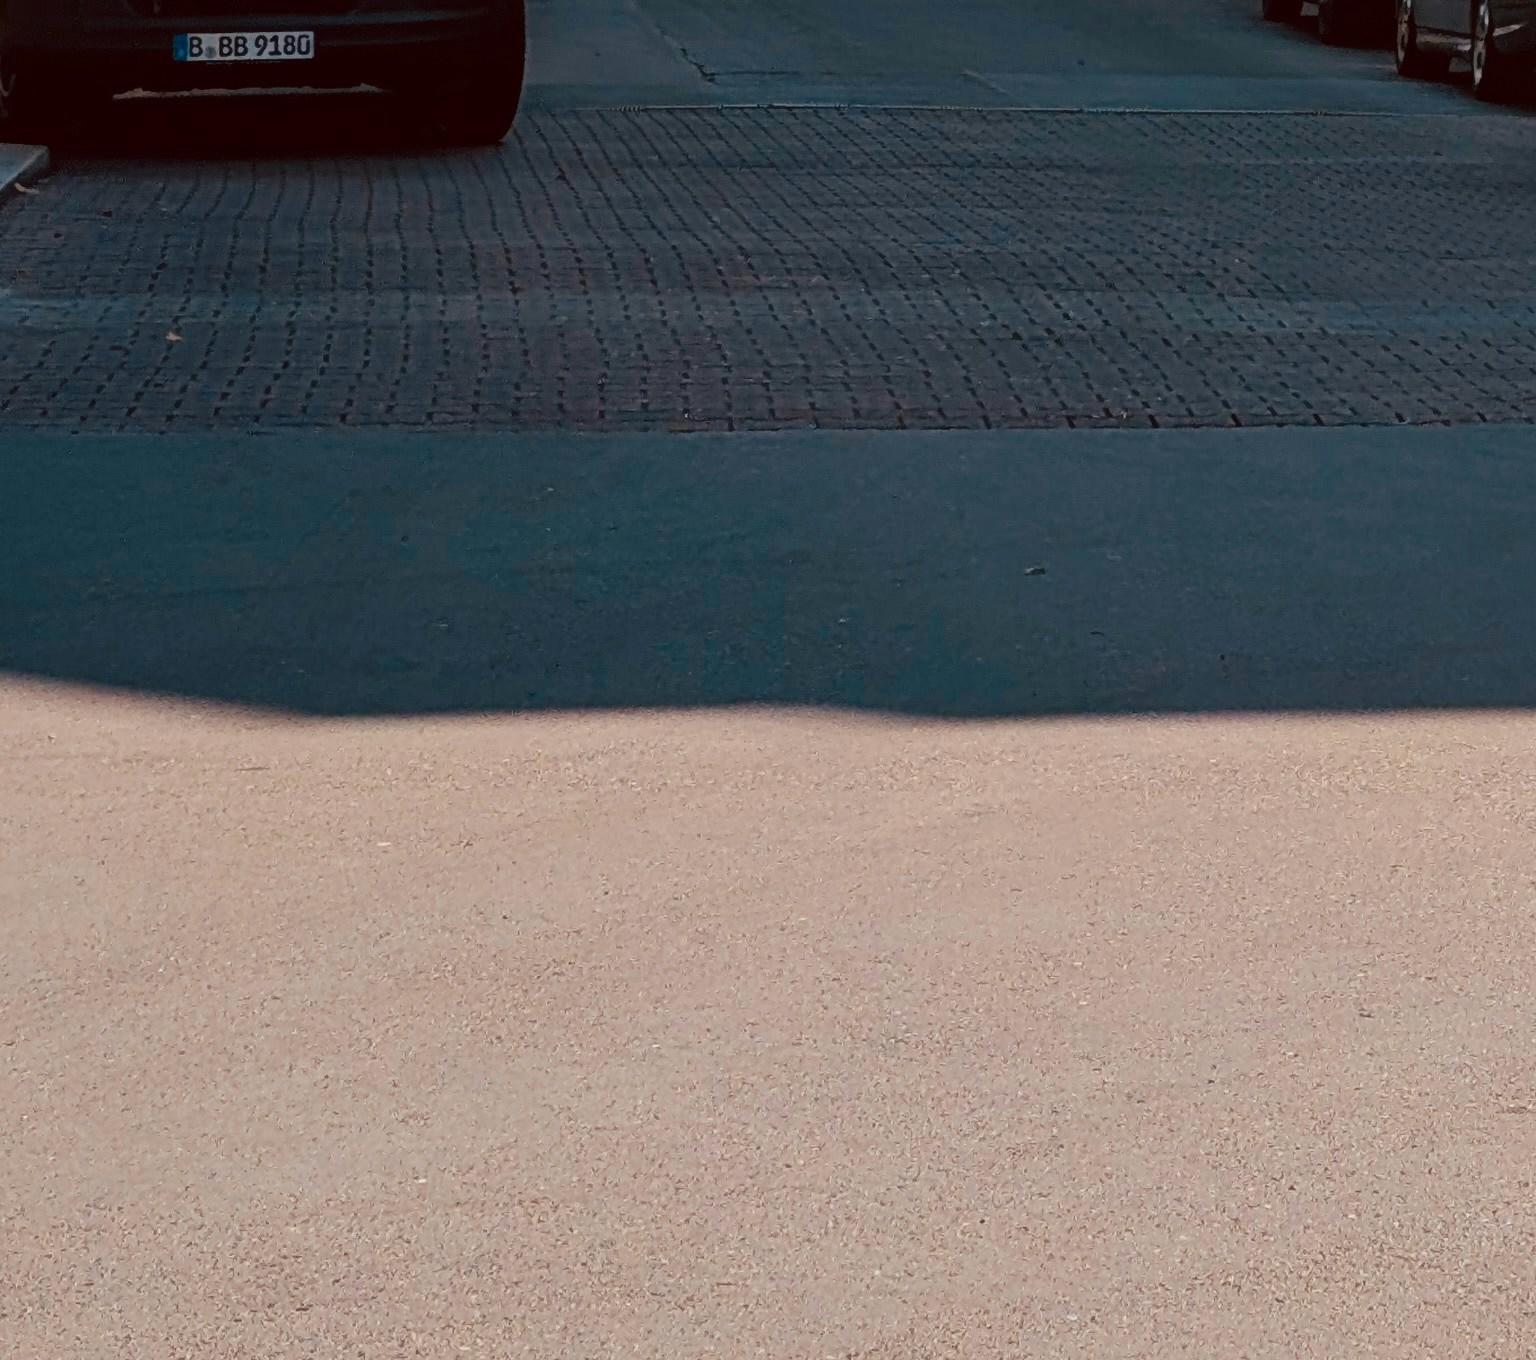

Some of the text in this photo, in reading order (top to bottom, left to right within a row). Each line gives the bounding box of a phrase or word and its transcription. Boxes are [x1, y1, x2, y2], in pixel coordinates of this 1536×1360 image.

[189, 33, 311, 58] B BB 9180
